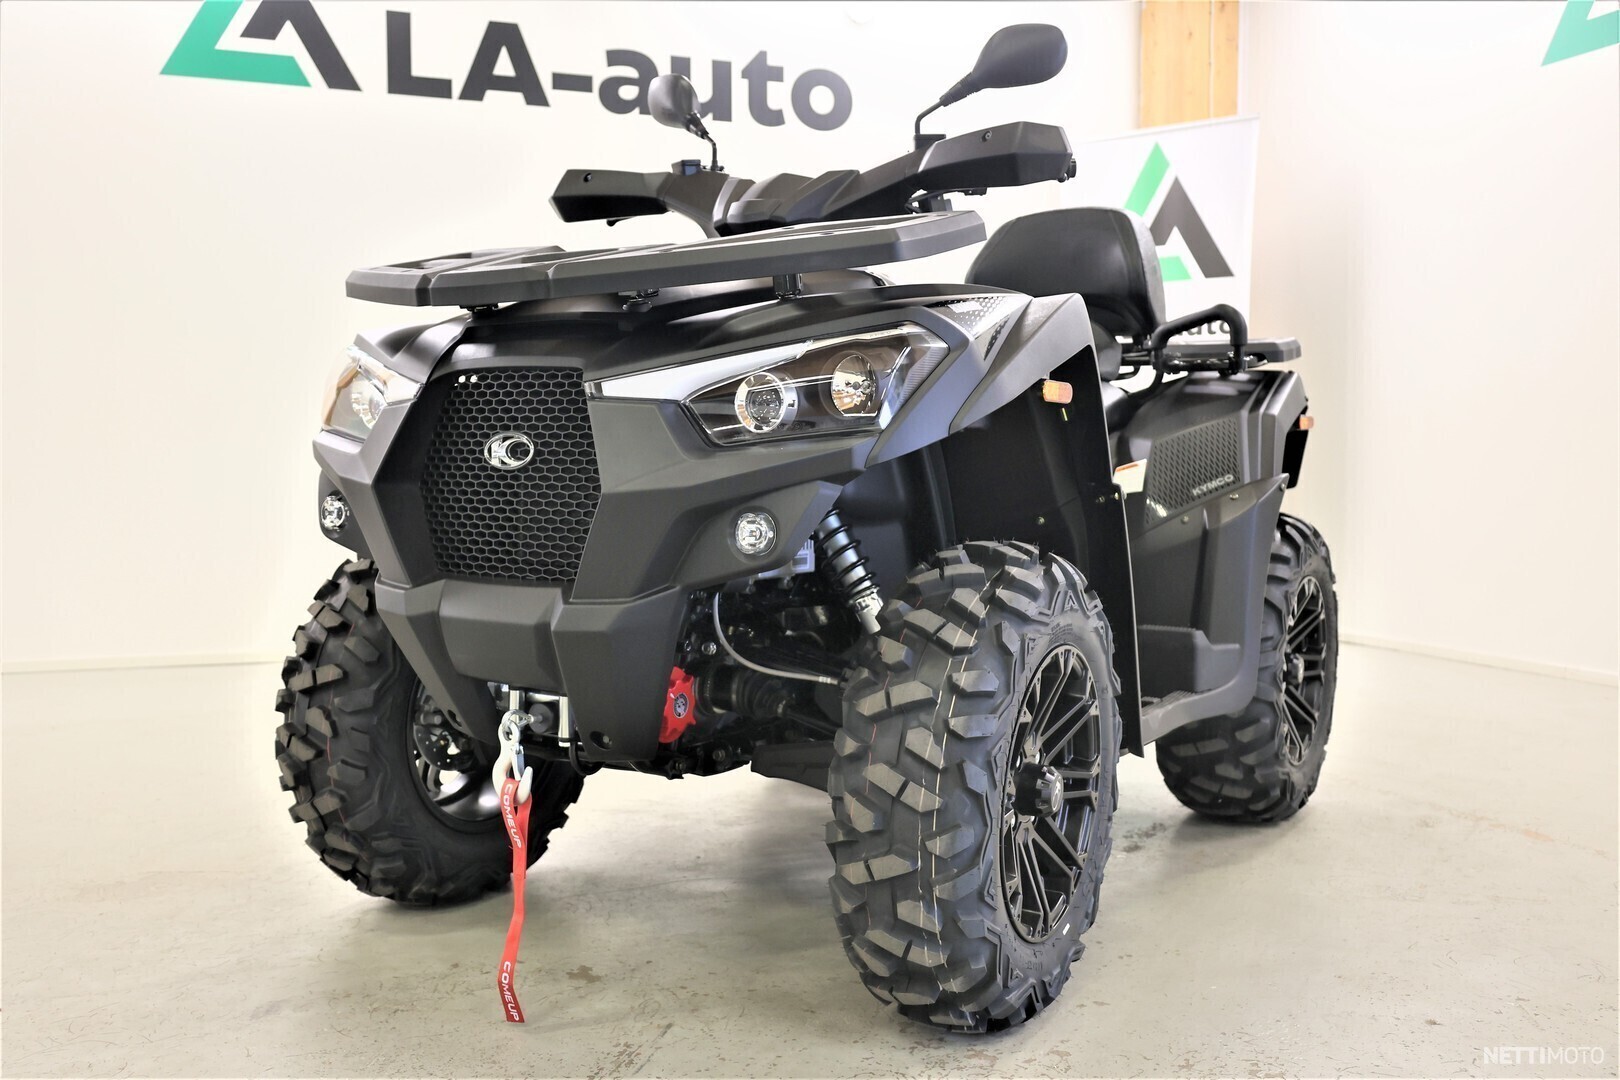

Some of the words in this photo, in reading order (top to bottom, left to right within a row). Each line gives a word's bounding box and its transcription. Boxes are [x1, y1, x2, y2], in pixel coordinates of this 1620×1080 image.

[386, 9, 853, 132] LA-auto
[1192, 474, 1234, 496] KYMCO
[503, 783, 522, 848] COMEUP
[501, 961, 520, 1021] COMEUP
